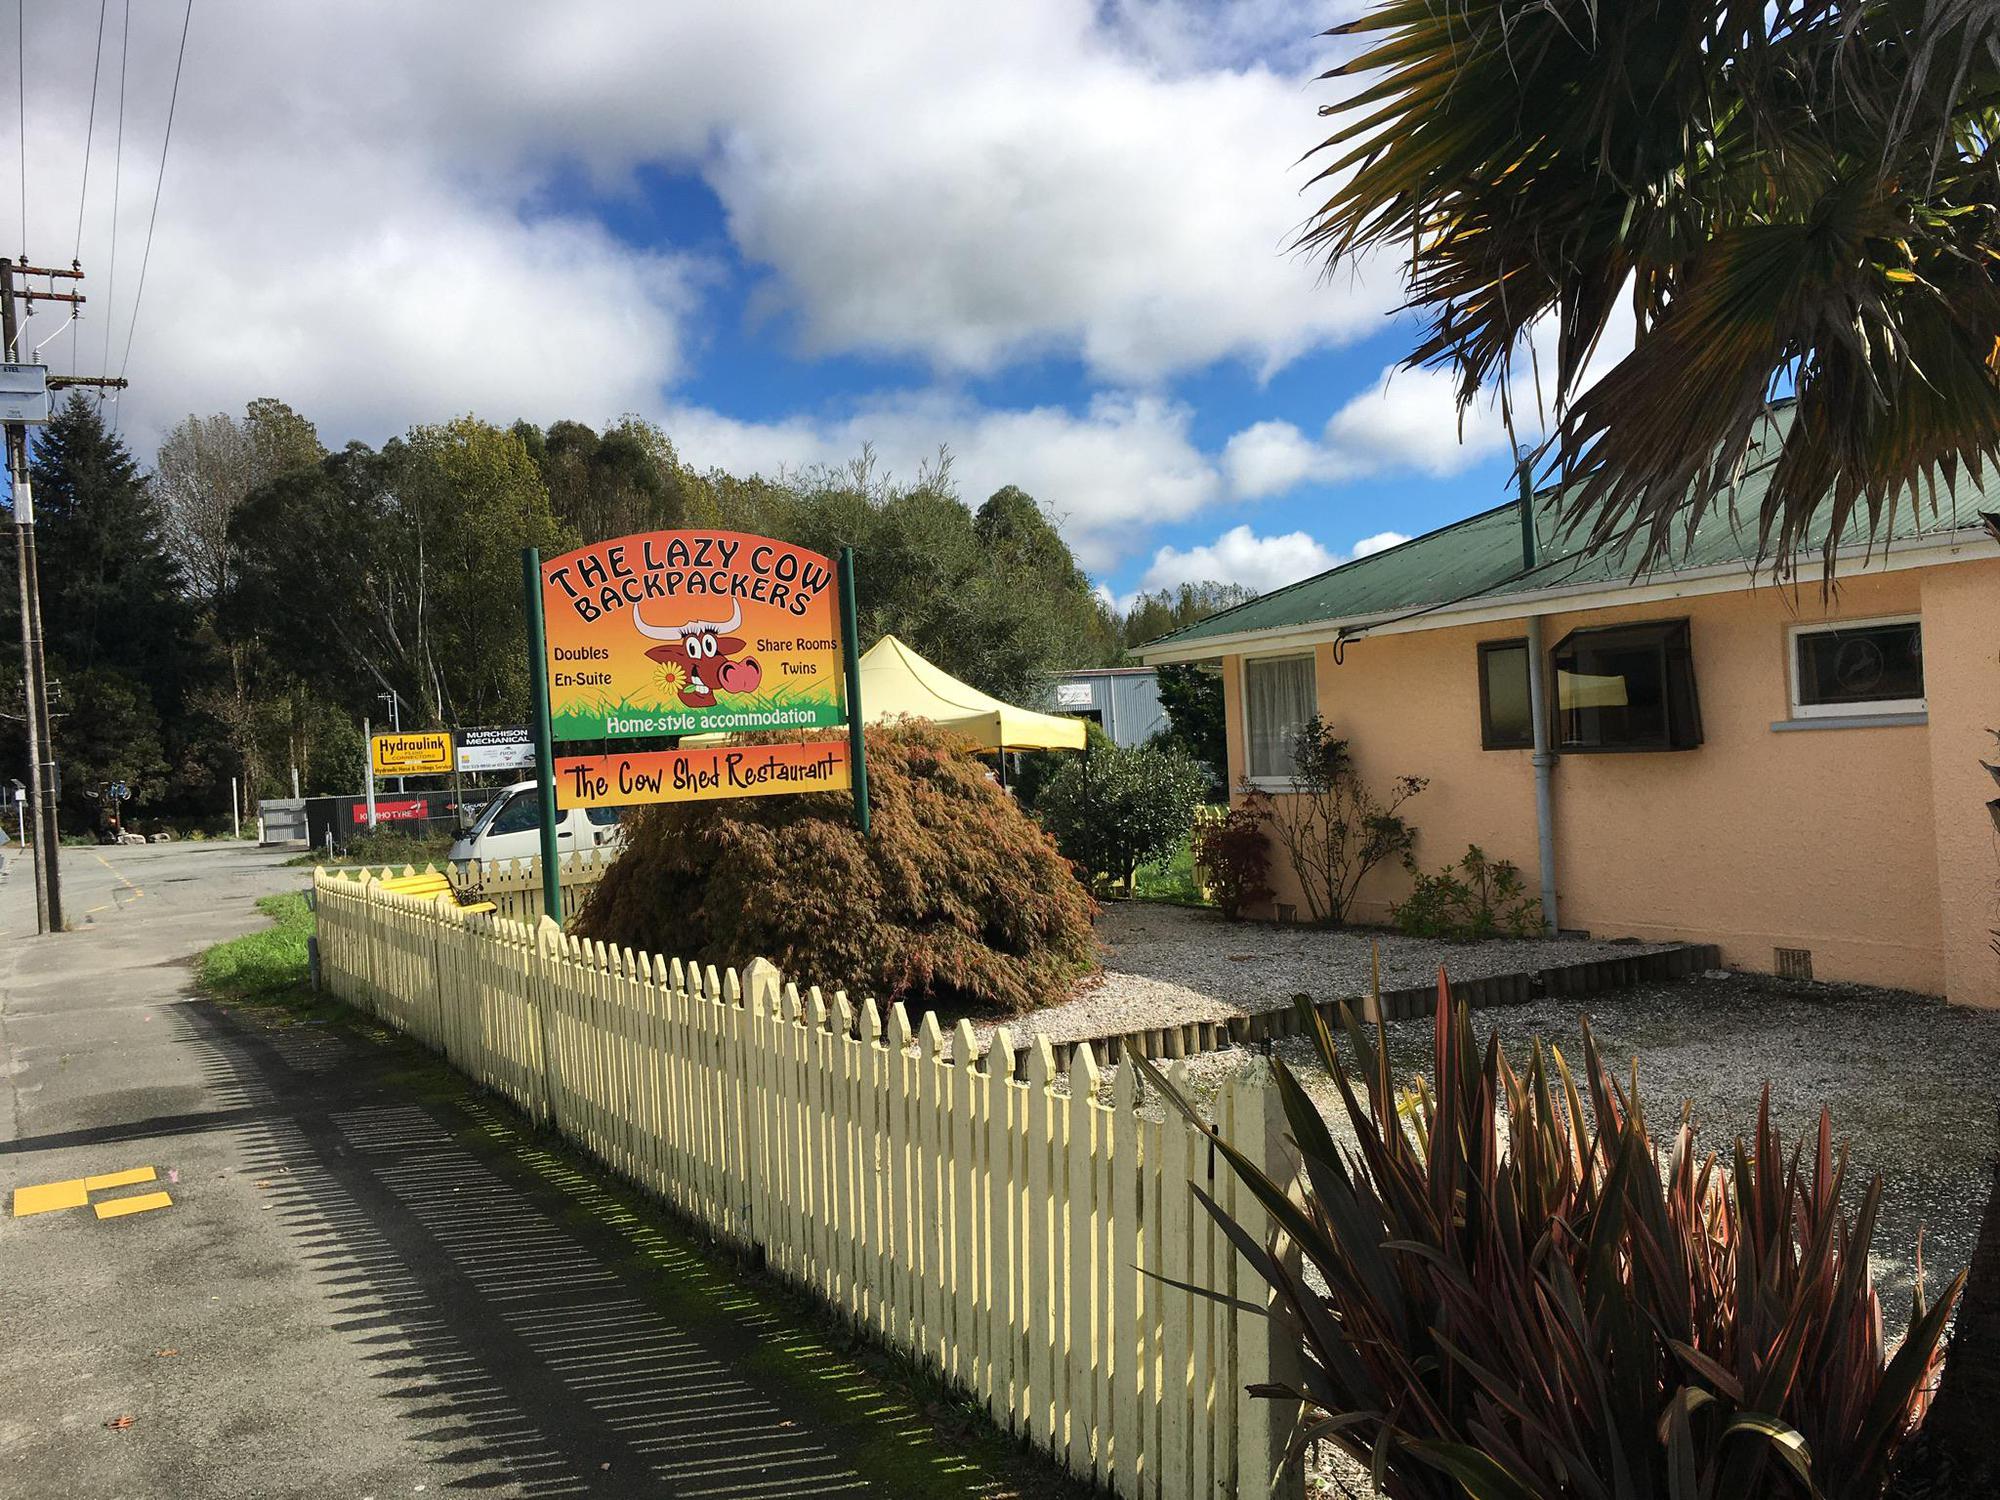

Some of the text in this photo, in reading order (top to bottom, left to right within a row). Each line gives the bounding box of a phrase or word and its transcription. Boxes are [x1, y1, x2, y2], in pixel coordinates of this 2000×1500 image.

[549, 538, 832, 598] THE LAZY COW
[573, 569, 811, 623] BACKPACKERS
[757, 638, 838, 653] Share Rooms
[554, 646, 609, 661] Doubles
[781, 662, 817, 676] Twins
[555, 671, 612, 686] En-Suite
[607, 708, 816, 734] Home-style accommodation
[466, 729, 528, 739] MURCHISON
[466, 736, 531, 745] MECHANICAL
[379, 736, 445, 755] Hydraulink
[564, 752, 843, 800] The Cow Shed Restaurant
[391, 810, 413, 818] TYRE
